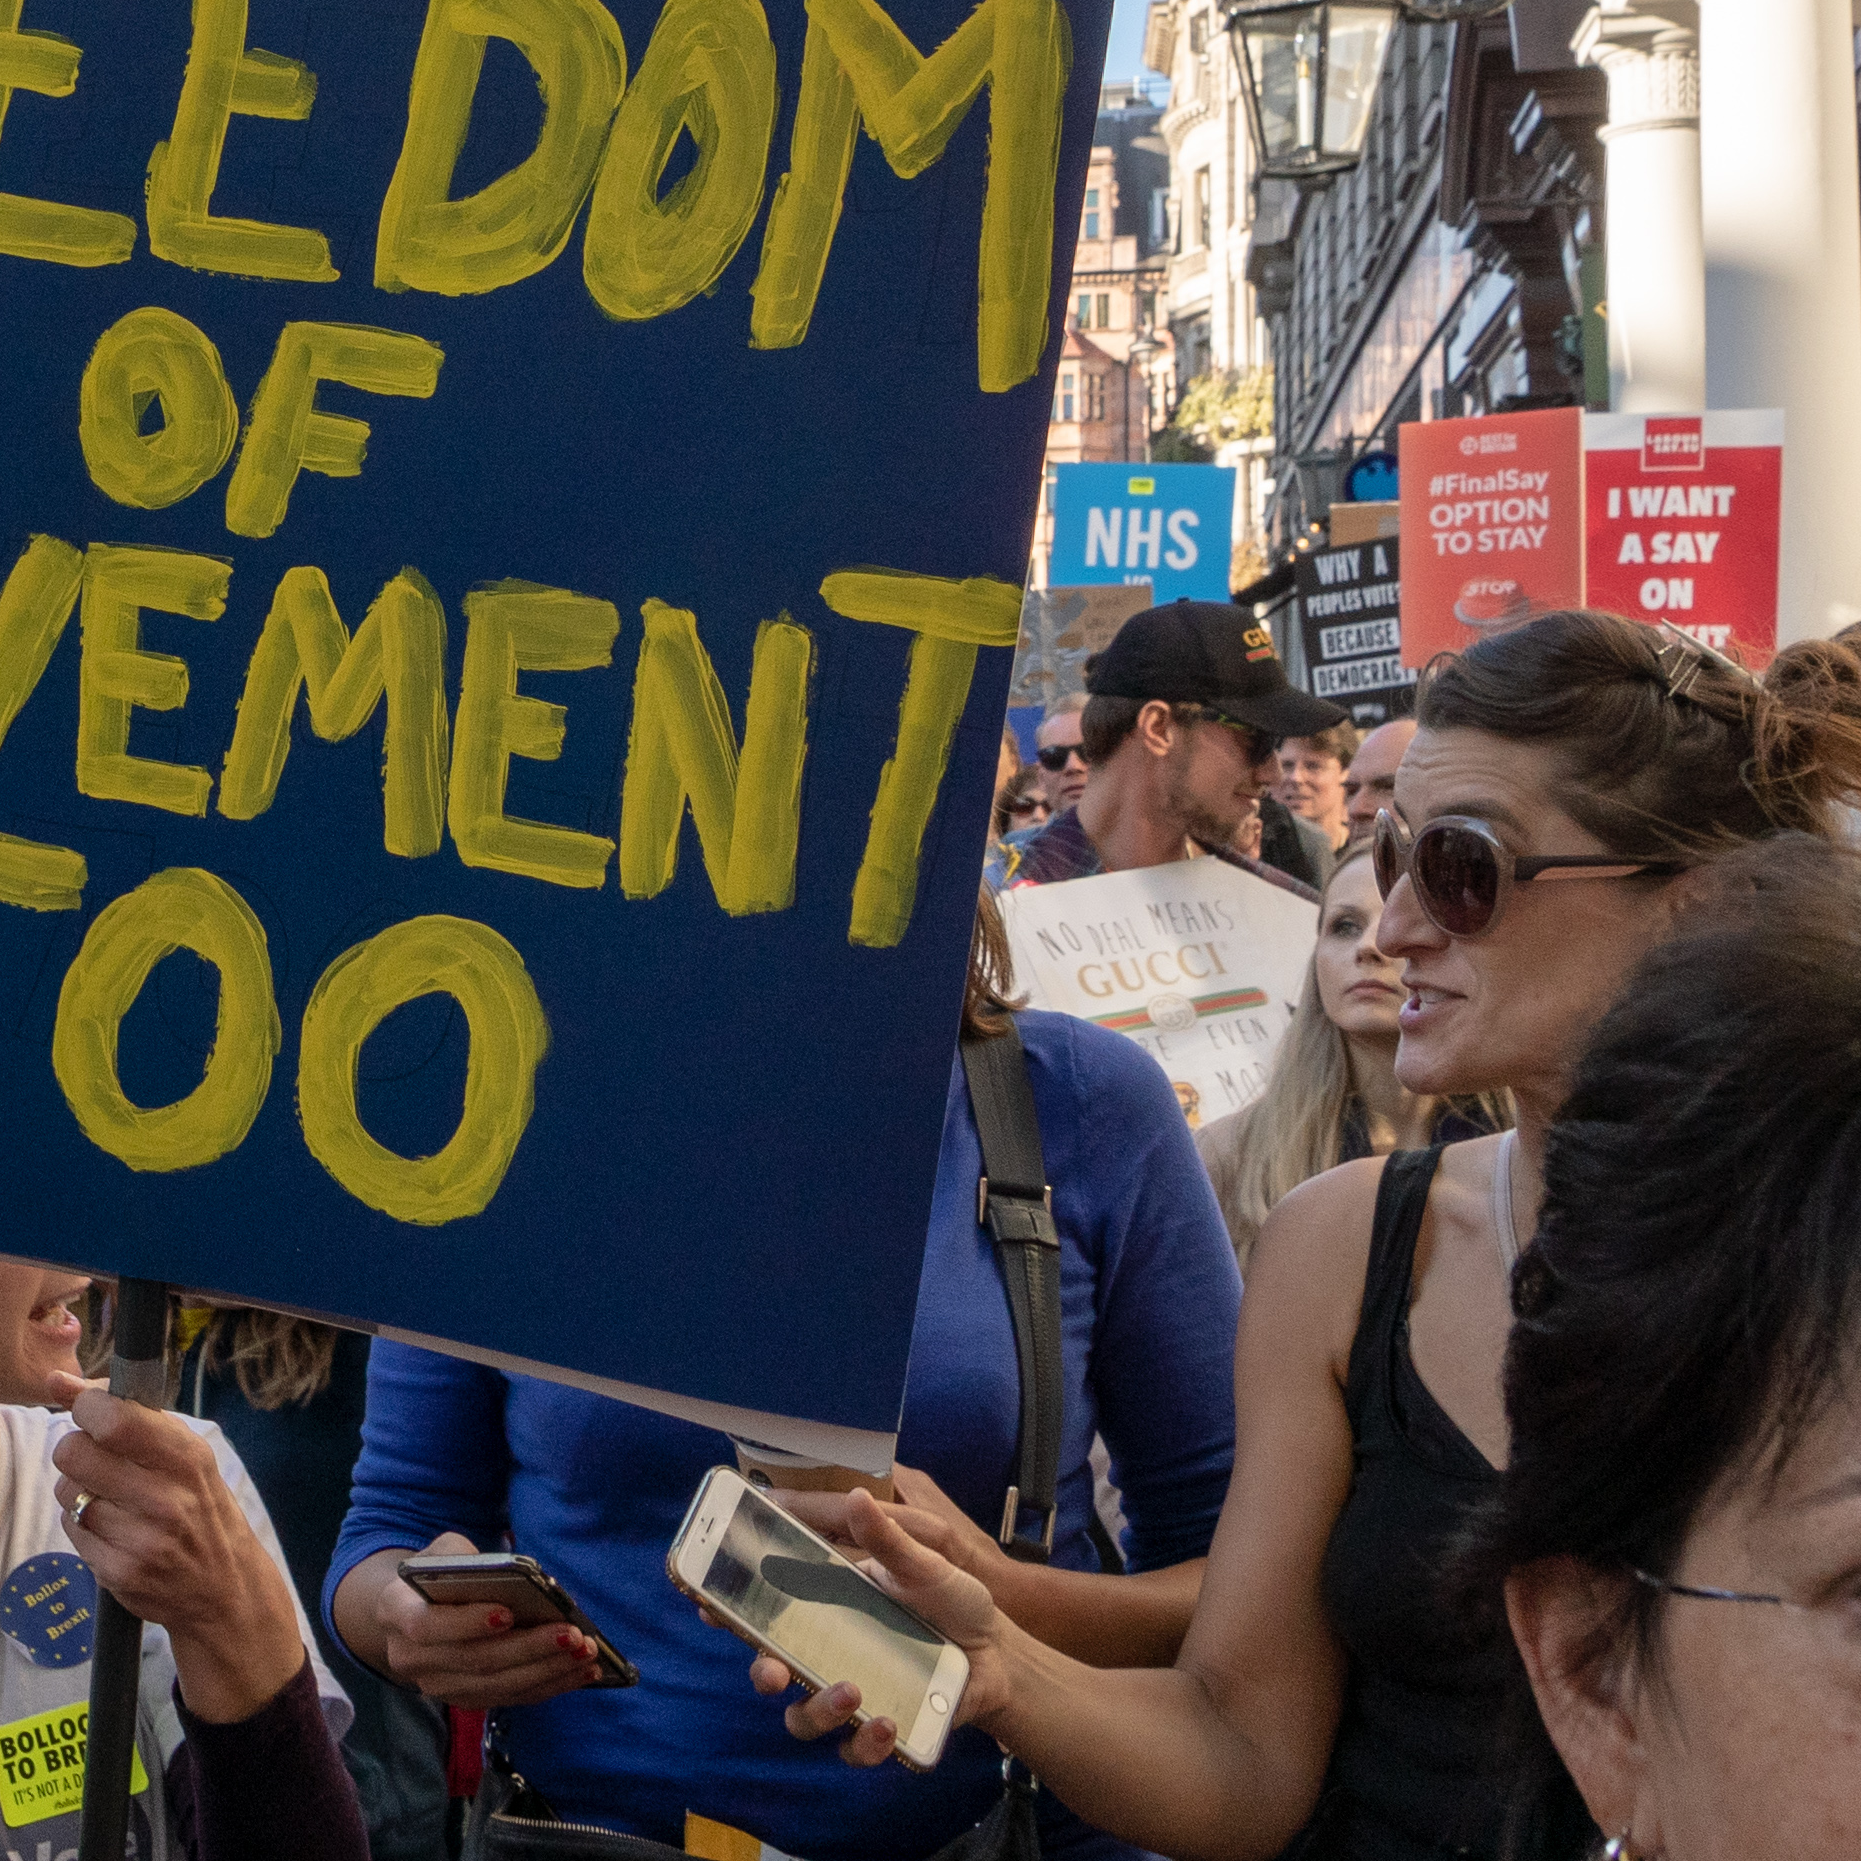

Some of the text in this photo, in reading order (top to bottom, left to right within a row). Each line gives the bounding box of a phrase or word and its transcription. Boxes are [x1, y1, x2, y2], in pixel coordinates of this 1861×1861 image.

[79, 307, 444, 538] OF
[1430, 467, 1549, 497] #FinalSay
[1429, 496, 1550, 529] OPTION
[1608, 484, 1737, 519] I WANT
[1085, 507, 1200, 571] NHS
[1432, 525, 1548, 556] TO STAY
[1617, 530, 1721, 565] A SAY
[1314, 544, 1389, 586] WHY A
[1465, 580, 1517, 597] STOP
[1640, 578, 1694, 610] ON
[1326, 621, 1394, 653] BECAUSE
[1036, 899, 1235, 962] NO DEAL MEANS
[1076, 941, 1228, 998] GUCCI
[1205, 1018, 1269, 1050] EVEN
[23, 1576, 70, 1608] Bollox
[46, 1607, 90, 1640] Brexit
[49, 1602, 66, 1615] to
[3, 1756, 36, 1785] TO
[13, 1787, 35, 1806] IT'S
[36, 1779, 60, 1799] NOT
[63, 1777, 72, 1791] A
